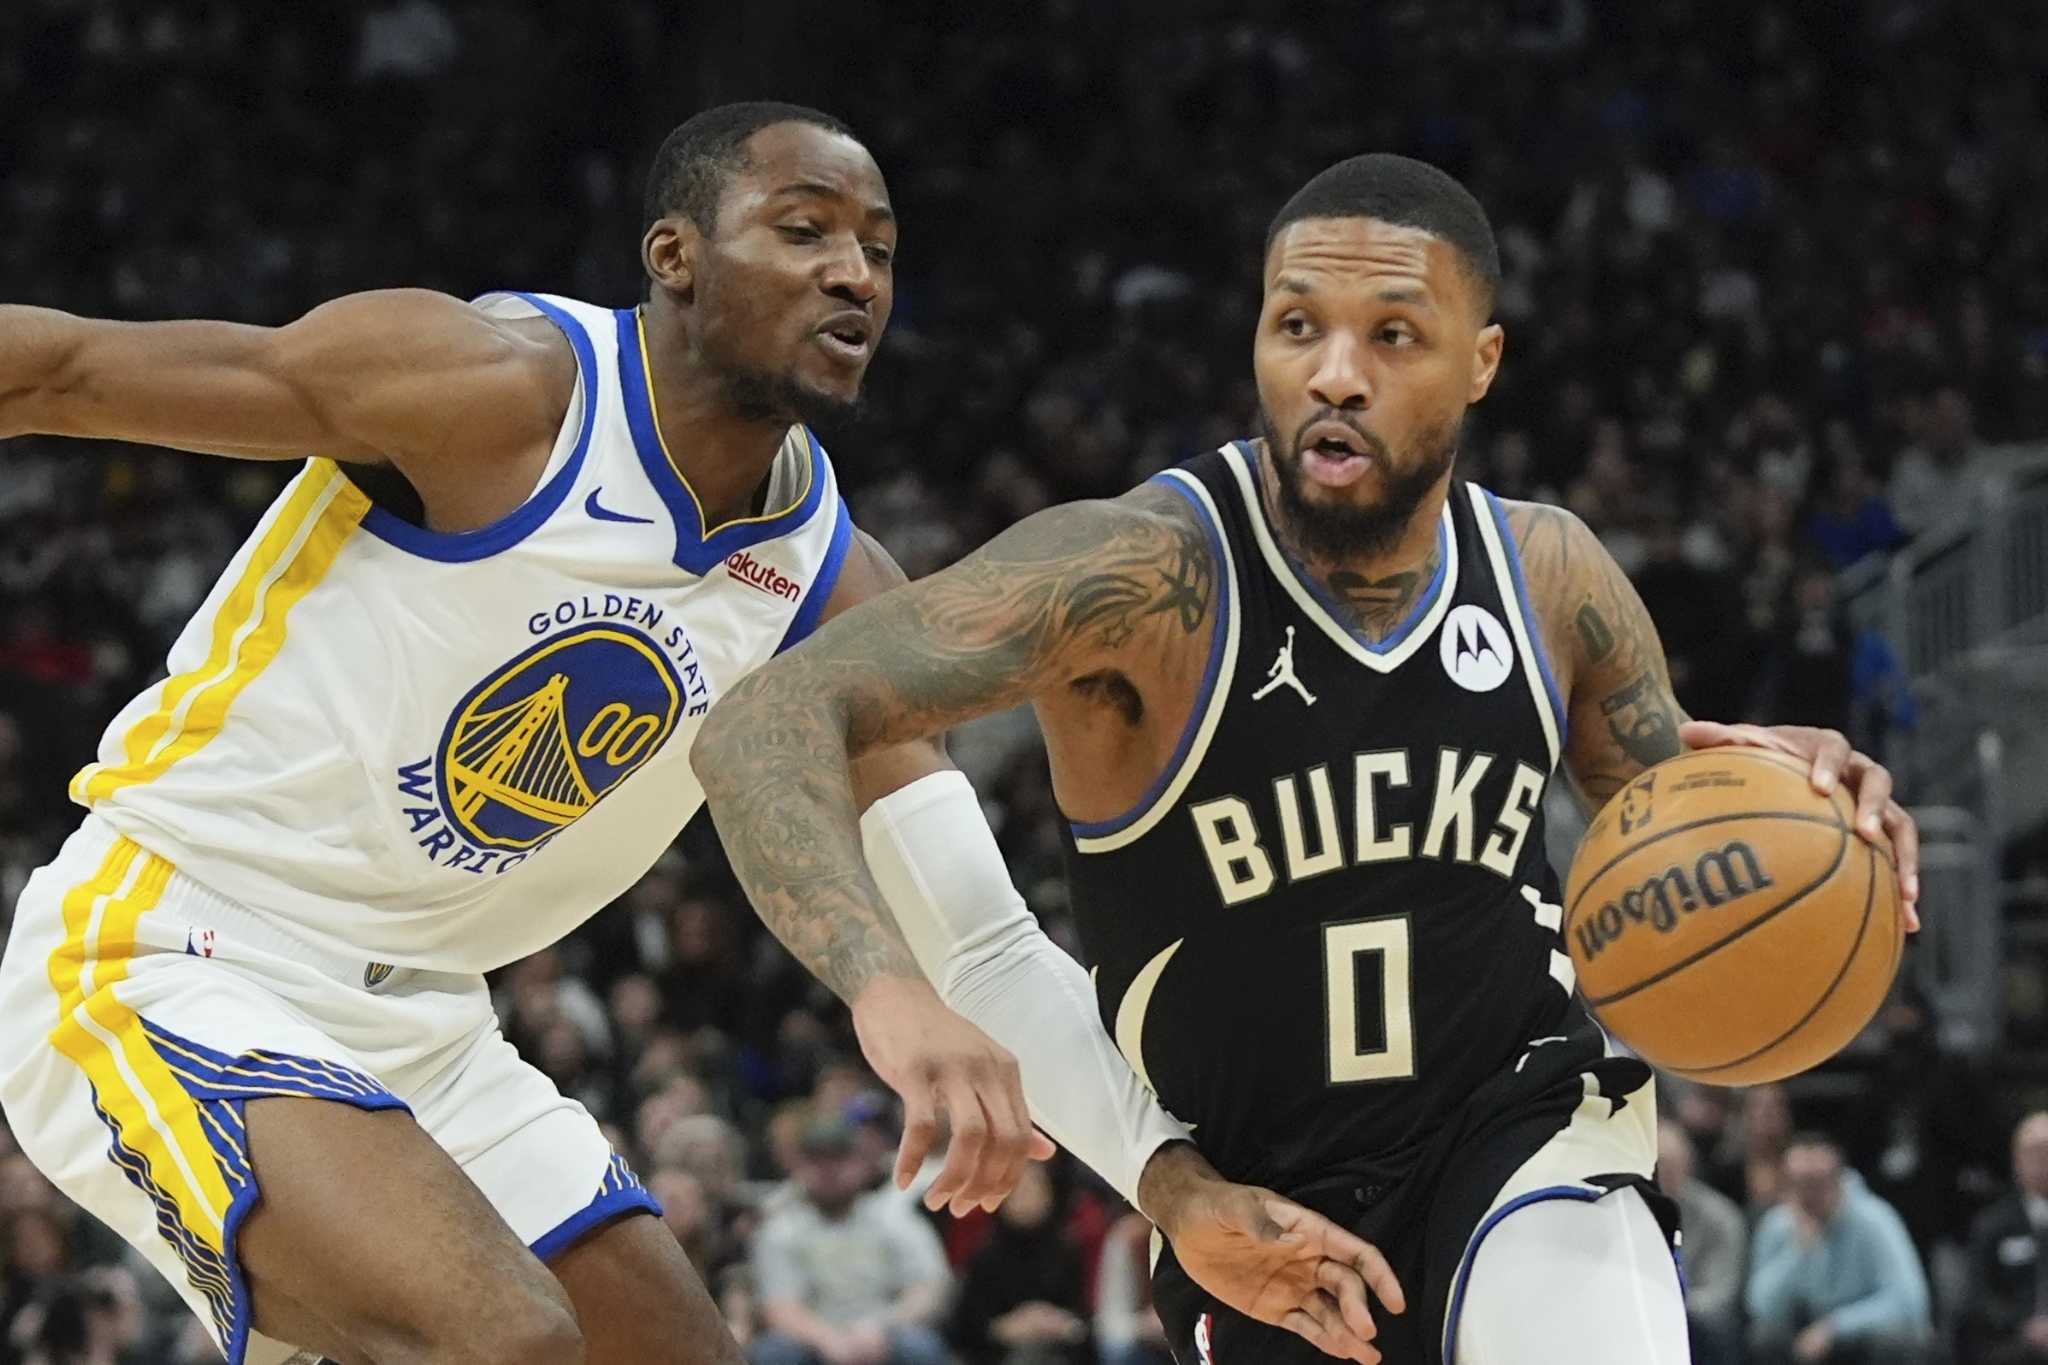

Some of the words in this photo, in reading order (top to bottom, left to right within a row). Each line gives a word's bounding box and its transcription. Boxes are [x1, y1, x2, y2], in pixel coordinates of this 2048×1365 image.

[724, 552, 801, 602] akuten
[528, 594, 664, 636] GOLDEN
[664, 626, 711, 718] STATE
[577, 702, 661, 766] 00
[1187, 745, 1547, 909] BUCKS
[1574, 841, 1775, 962] Wilson
[1320, 912, 1419, 1087] 0
